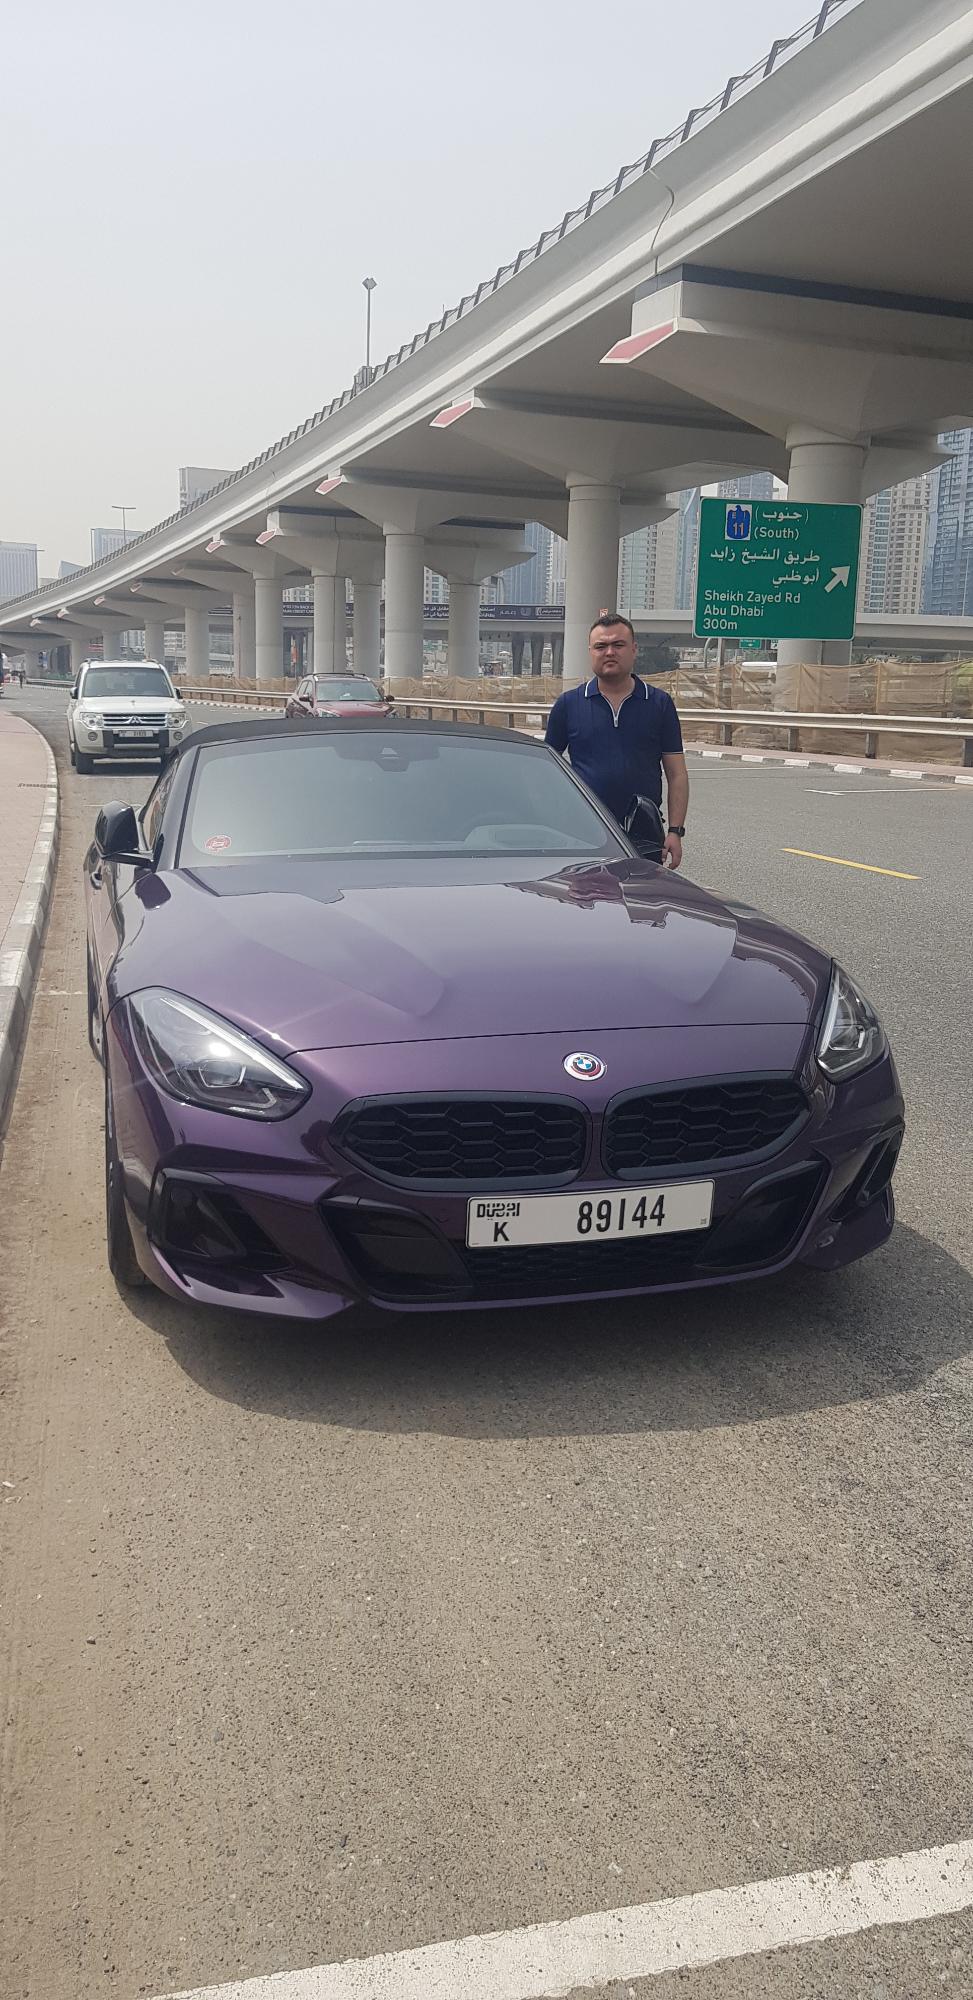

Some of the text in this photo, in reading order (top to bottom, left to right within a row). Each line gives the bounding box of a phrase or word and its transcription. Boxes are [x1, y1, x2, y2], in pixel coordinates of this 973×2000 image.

[733, 522, 744, 537] 11
[754, 526, 799, 541] (South)
[710, 546, 820, 565] طريق الشيخ زايد
[704, 590, 801, 605] Sheikh Zayed Rd
[704, 604, 764, 617] Abu Dhabi
[703, 617, 738, 630] 300m
[476, 1202, 520, 1218] DUBAI
[576, 1194, 665, 1234] 89144
[493, 1222, 510, 1242] K
